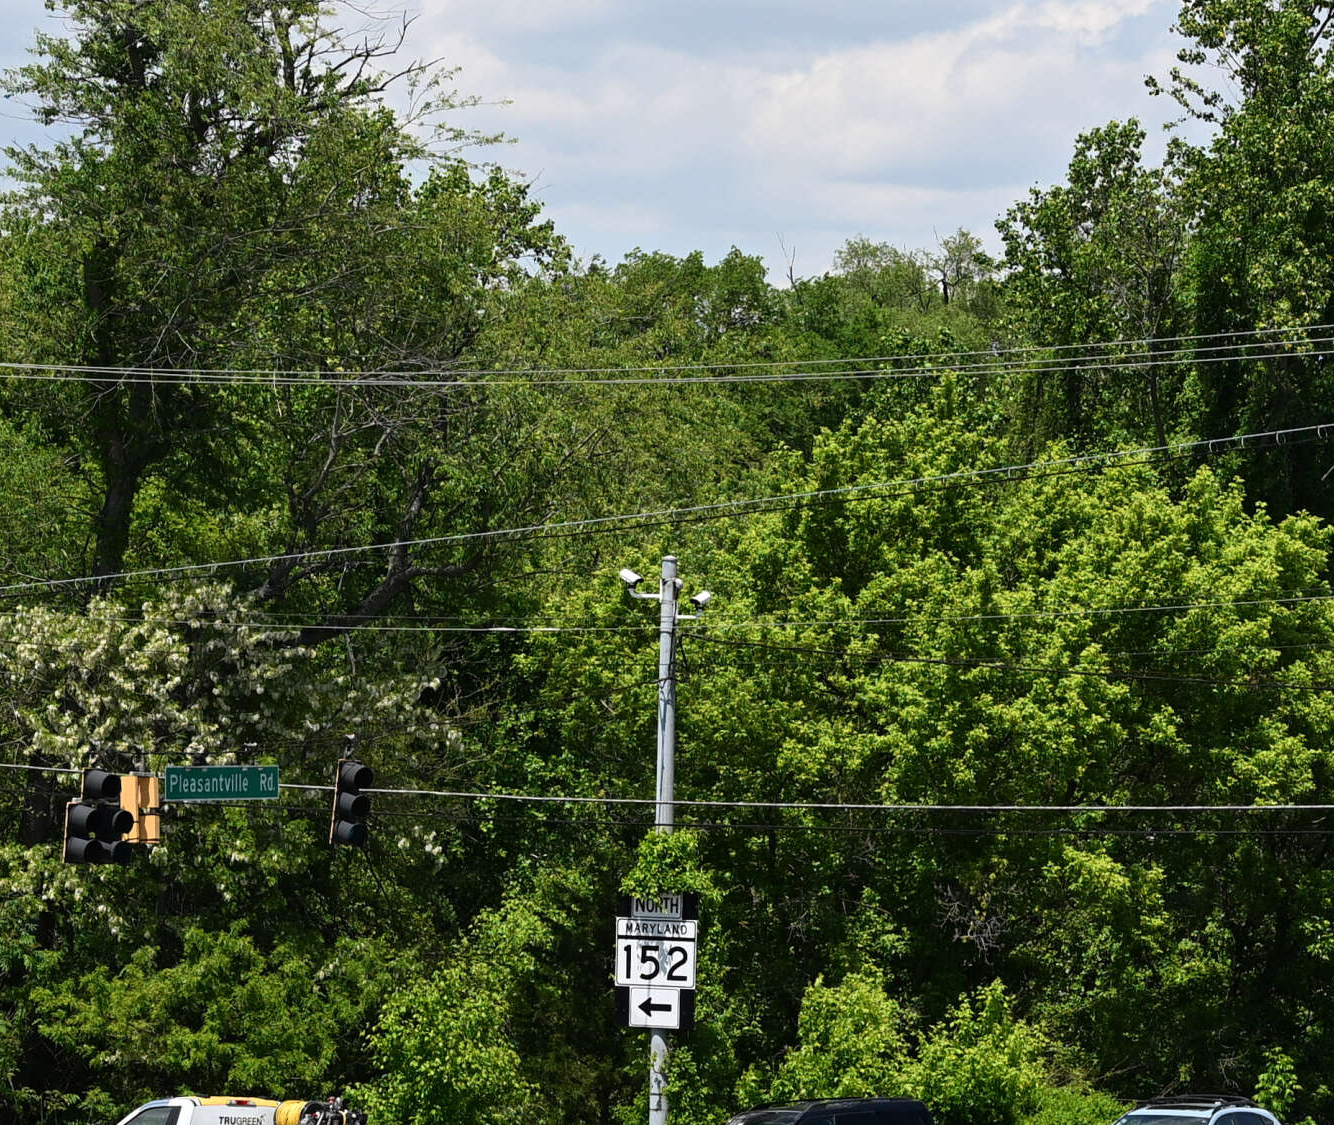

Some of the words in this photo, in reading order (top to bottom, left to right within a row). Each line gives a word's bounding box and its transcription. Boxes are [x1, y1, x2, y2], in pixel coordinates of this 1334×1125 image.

[169, 773, 249, 794] Pleasantville
[259, 773, 276, 792] Rd.
[635, 896, 679, 914] NORTH
[625, 922, 688, 935] MARYLAND
[623, 944, 688, 982] 152
[218, 1116, 263, 1125] TRUGREEN
